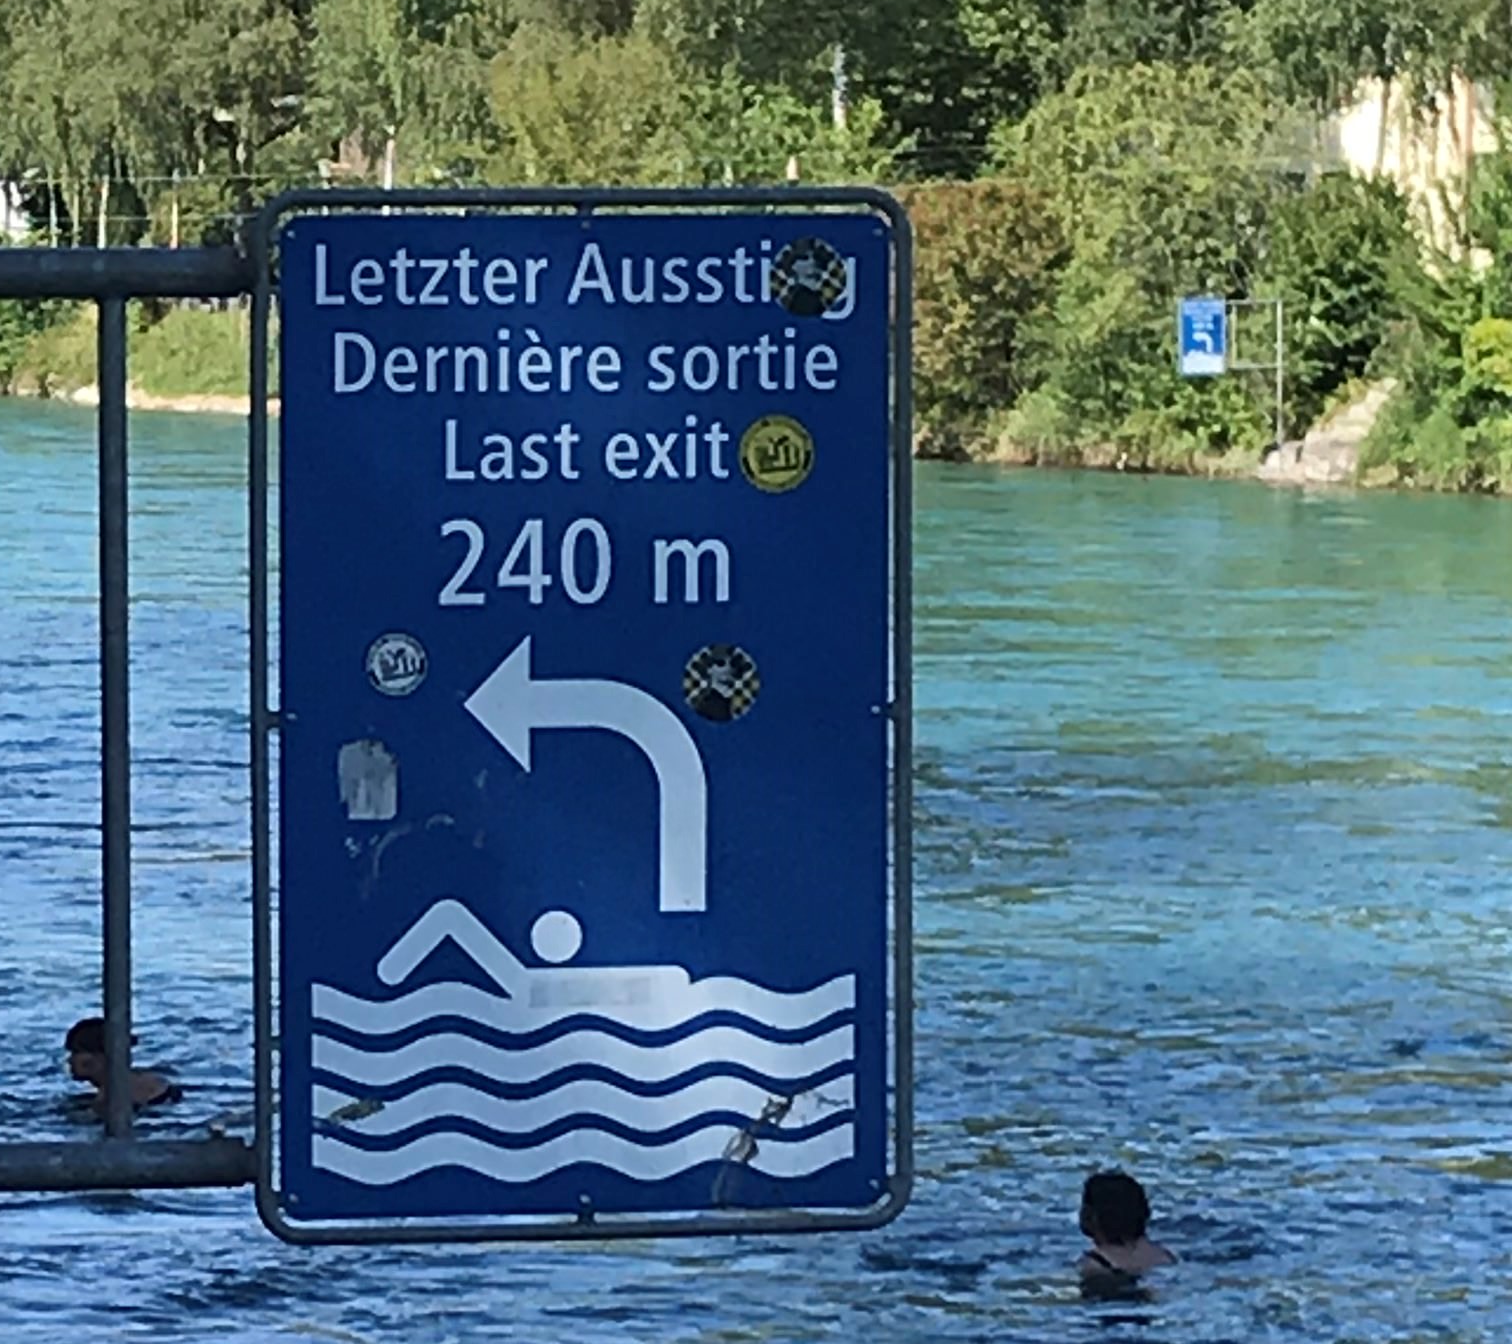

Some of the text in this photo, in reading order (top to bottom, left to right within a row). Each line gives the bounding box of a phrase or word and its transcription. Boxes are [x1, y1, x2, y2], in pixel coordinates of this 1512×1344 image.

[315, 239, 856, 319] Letzter Ausstig
[333, 327, 838, 393] Dernière sortie
[445, 419, 580, 480] Last
[605, 414, 729, 479] exit
[439, 518, 730, 605] 240 m
